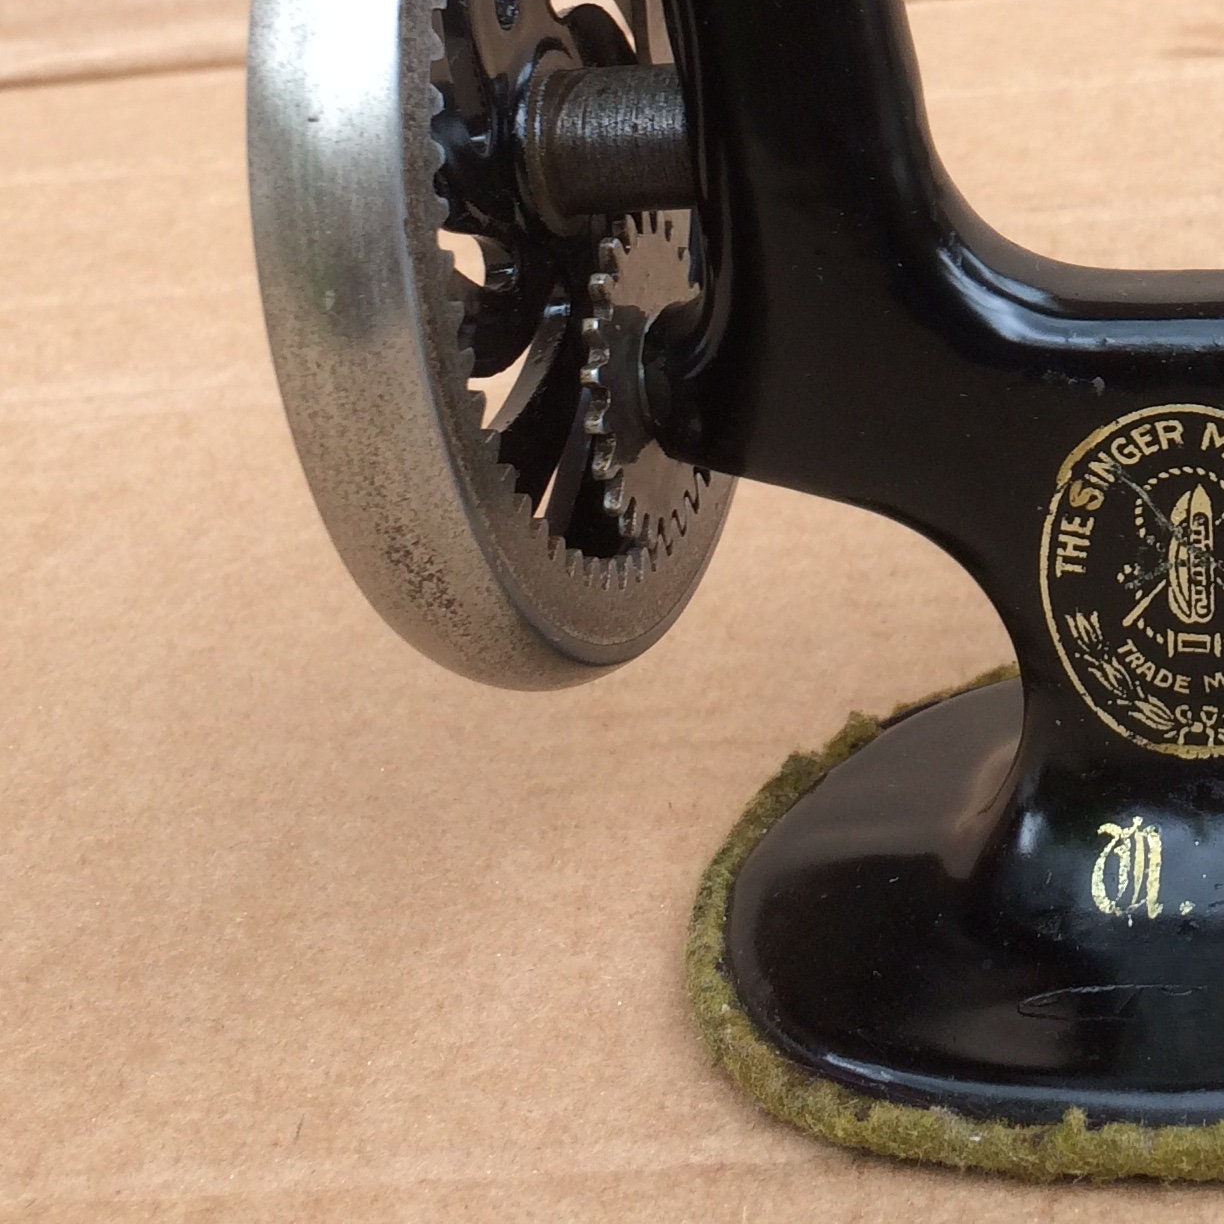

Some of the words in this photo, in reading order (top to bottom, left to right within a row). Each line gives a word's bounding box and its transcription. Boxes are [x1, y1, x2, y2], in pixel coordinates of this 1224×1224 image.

[1070, 420, 1184, 511] SINGER
[1056, 514, 1094, 578] THE
[1117, 639, 1190, 694] TRADE
